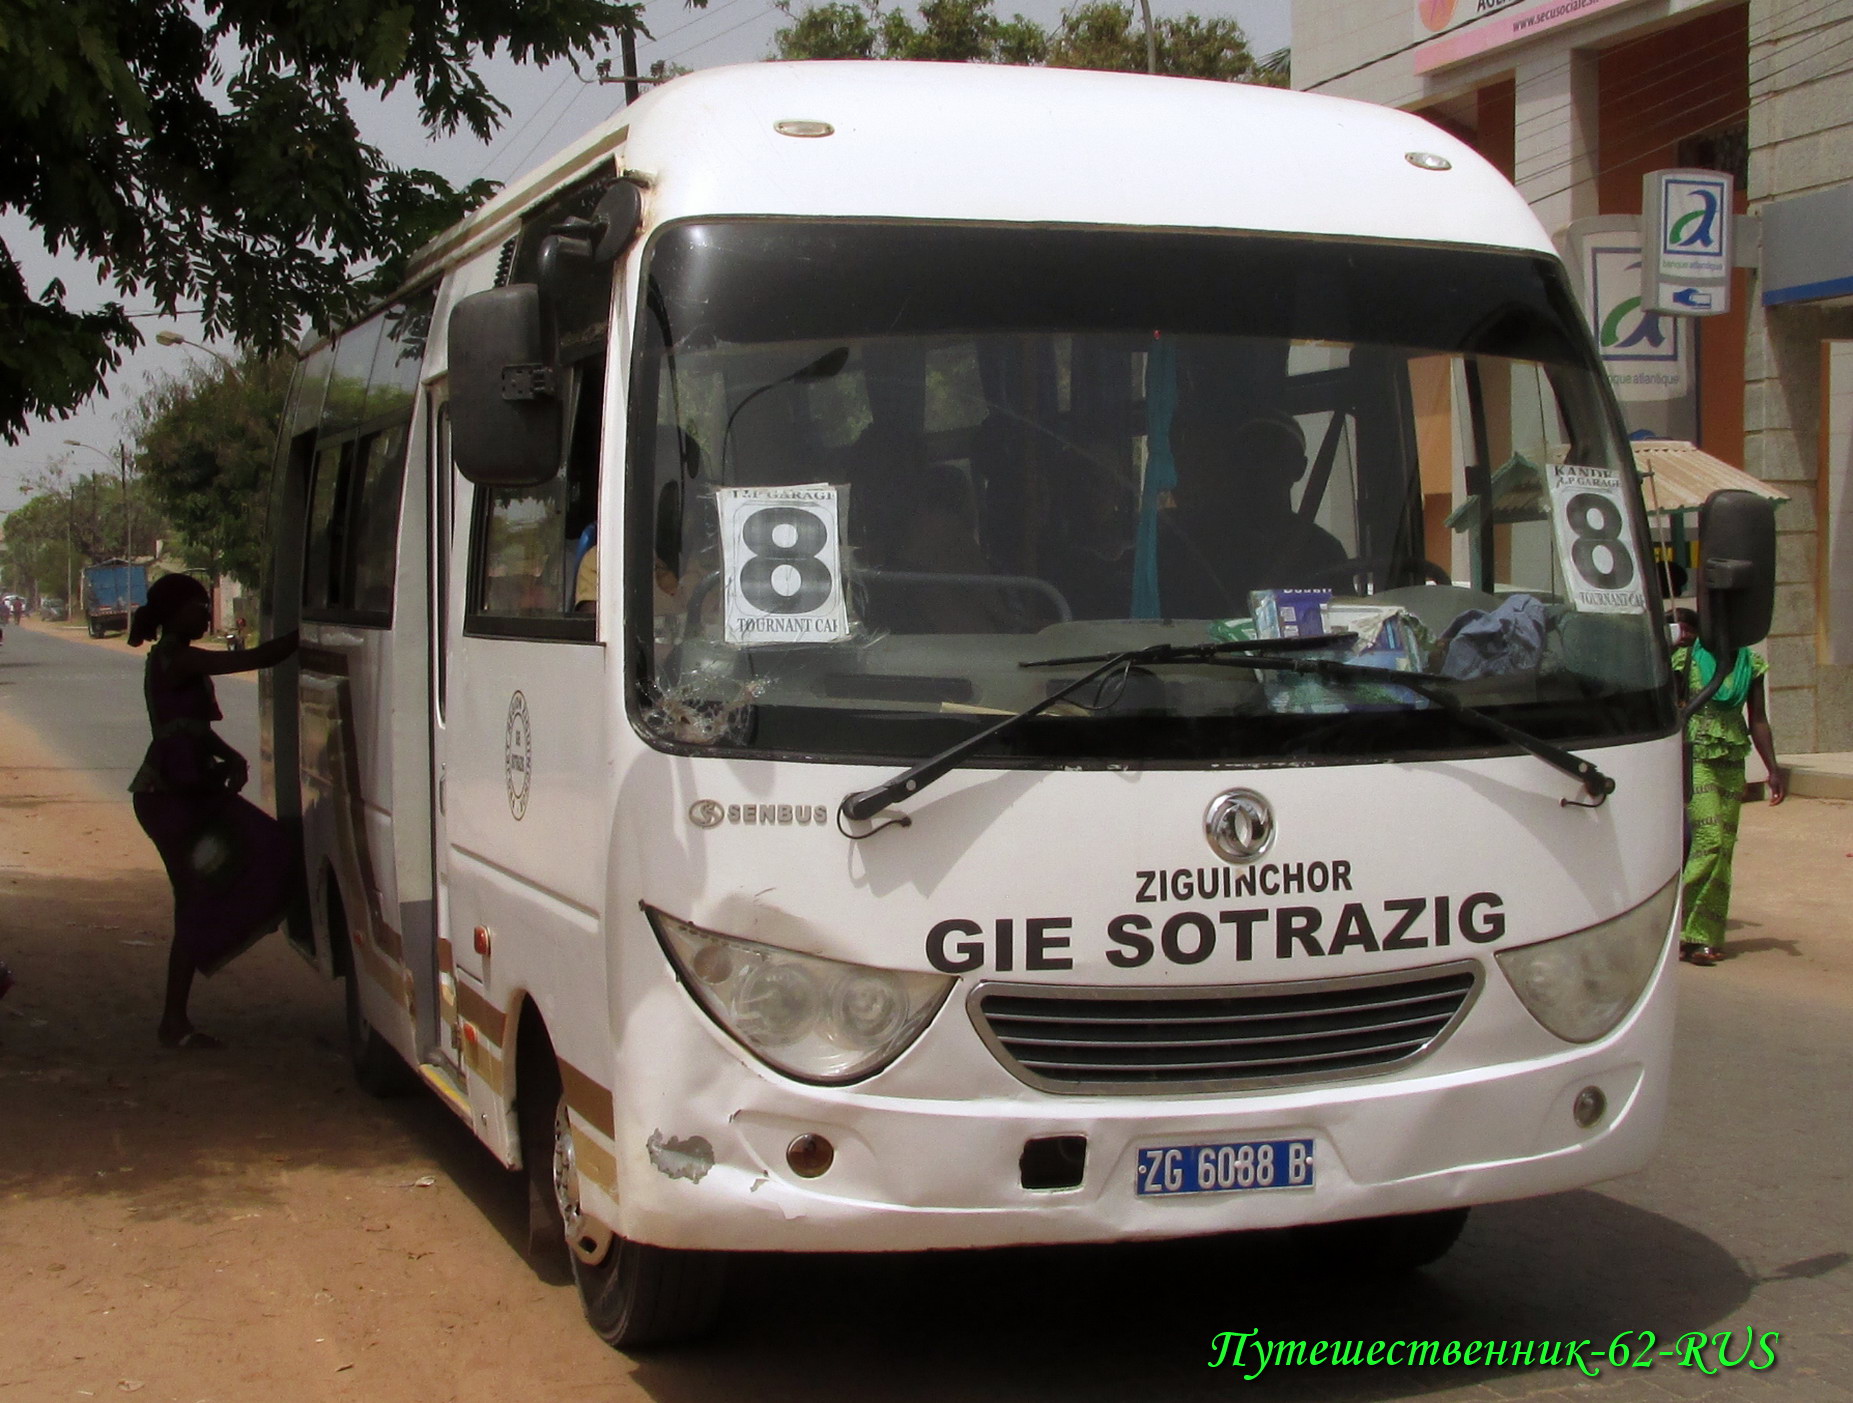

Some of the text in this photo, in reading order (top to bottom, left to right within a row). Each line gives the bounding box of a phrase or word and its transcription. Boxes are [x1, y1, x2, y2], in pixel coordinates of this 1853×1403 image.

[739, 507, 832, 614] 8
[1566, 492, 1634, 590] 8
[1579, 591, 1628, 607] TOURNANT
[737, 618, 814, 632] TOURNANT
[727, 803, 828, 826] SENBUS
[1135, 859, 1353, 903] ZIGUINCHOR
[925, 892, 1507, 974] GIE SOTRAZIG
[1144, 1142, 1306, 1192] ZG 6088 B
